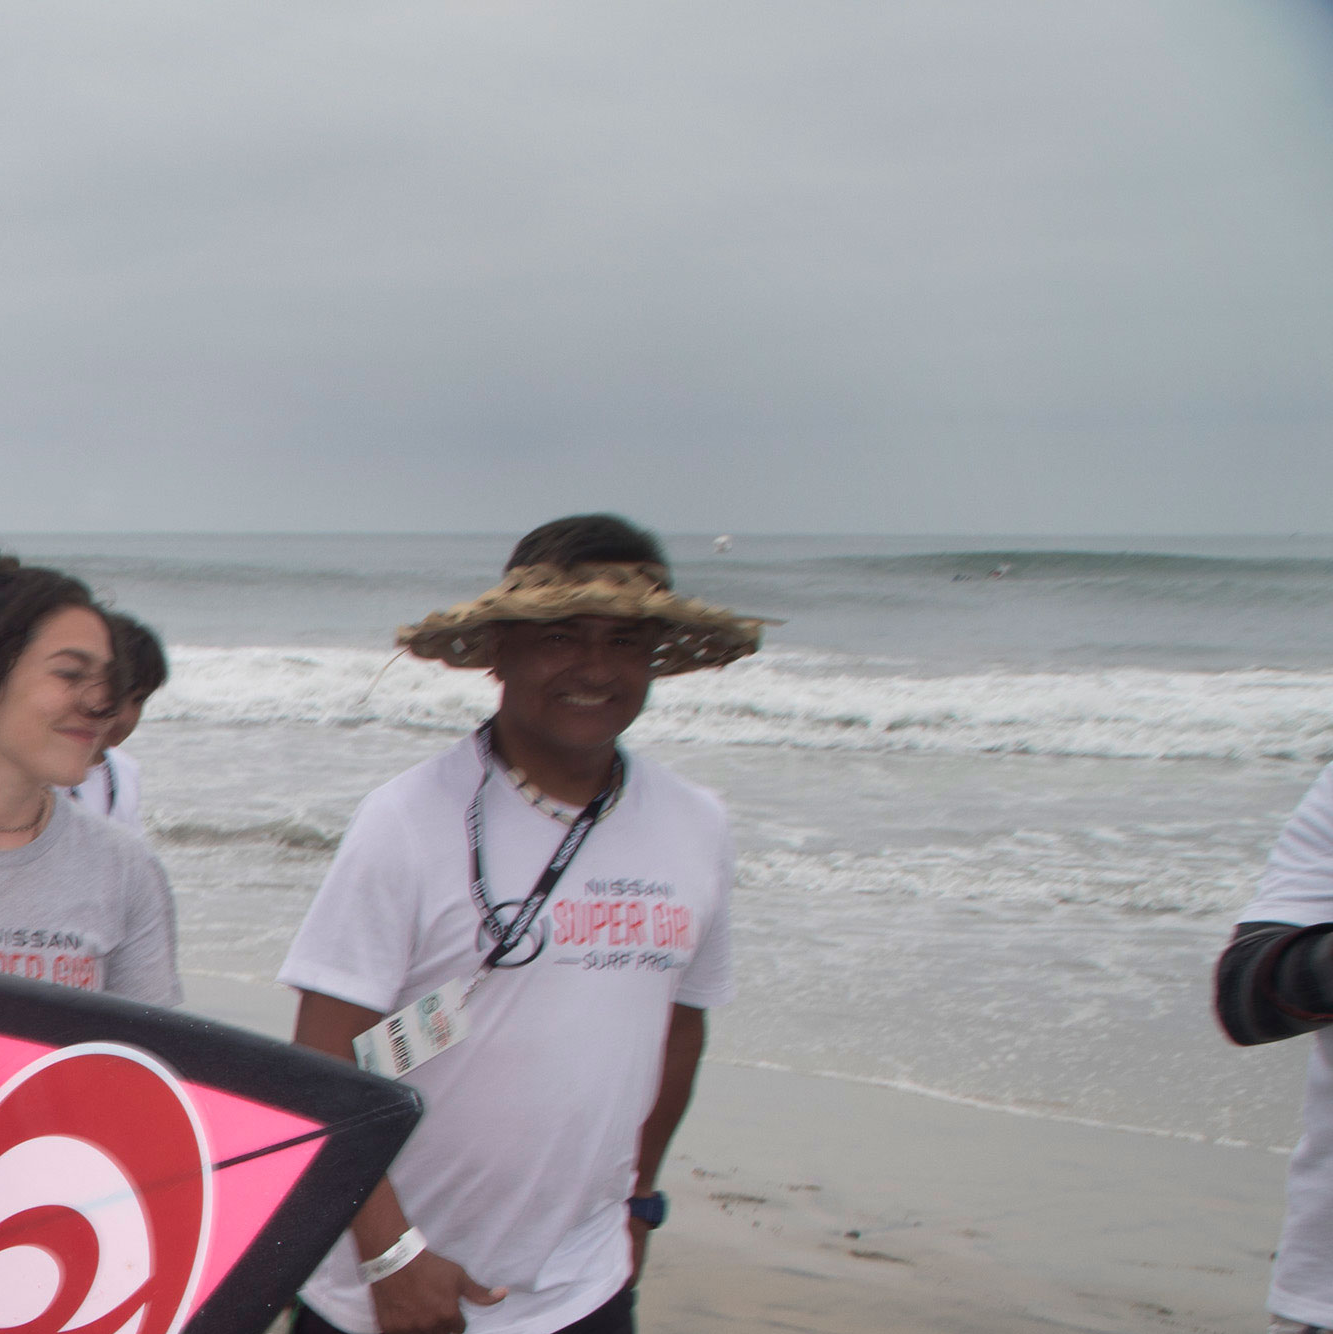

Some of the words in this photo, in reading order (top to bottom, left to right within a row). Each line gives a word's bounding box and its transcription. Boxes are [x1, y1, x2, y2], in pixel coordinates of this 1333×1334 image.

[584, 878, 673, 898] NISSAN
[553, 899, 647, 946] SUPER
[582, 951, 632, 971] SURF
[634, 951, 672, 972] PRO
